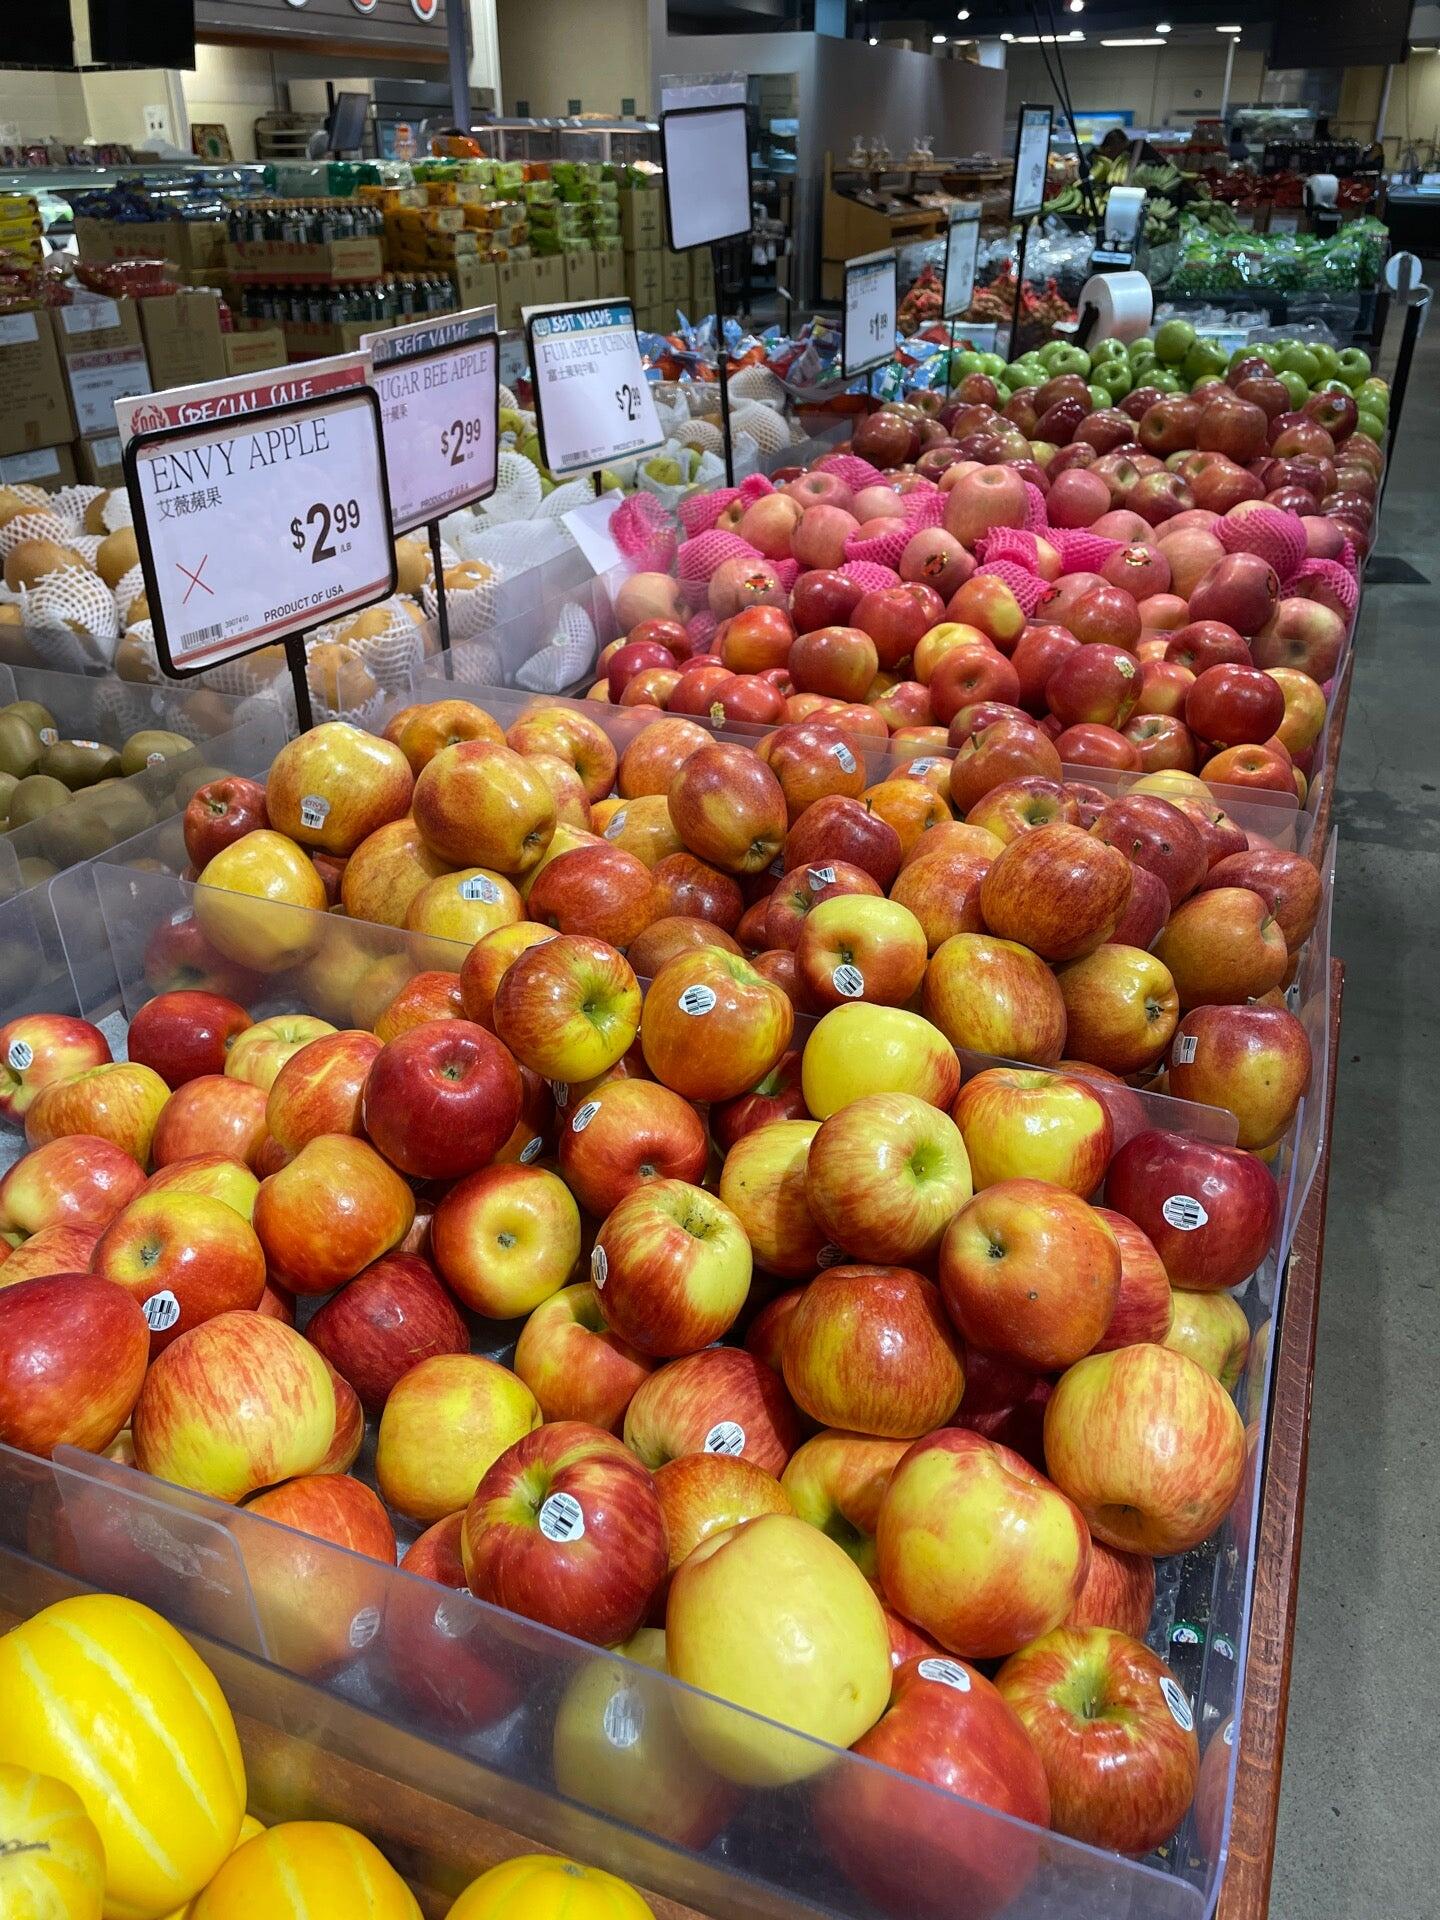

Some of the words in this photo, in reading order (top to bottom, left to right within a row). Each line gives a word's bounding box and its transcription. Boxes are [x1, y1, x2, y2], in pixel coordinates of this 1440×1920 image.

[542, 341, 569, 364] FUJI
[374, 372, 421, 403] UGAR
[424, 362, 448, 391] BEE
[451, 351, 488, 382] APPLE
[148, 440, 236, 494] ENVY
[249, 417, 330, 471] APPLE
[156, 486, 223, 522] 艾薇蘋果
[264, 597, 309, 622] PRODUCT
[311, 591, 324, 604] OF
[325, 584, 345, 599] USA
